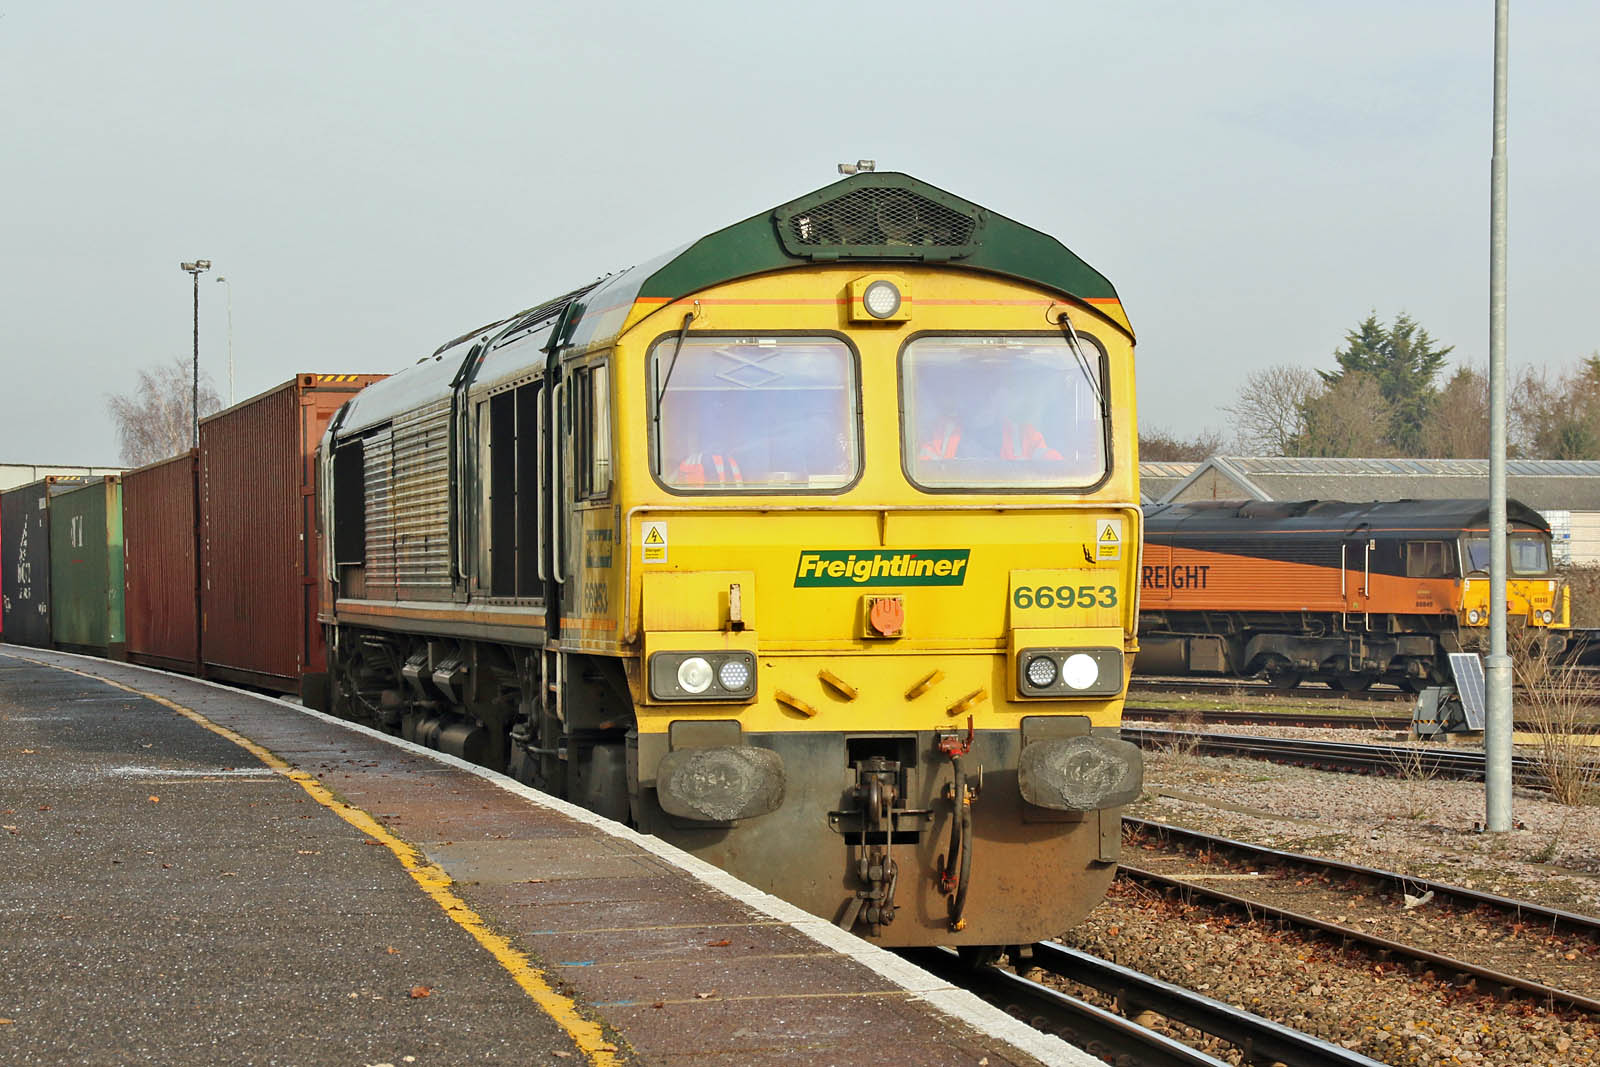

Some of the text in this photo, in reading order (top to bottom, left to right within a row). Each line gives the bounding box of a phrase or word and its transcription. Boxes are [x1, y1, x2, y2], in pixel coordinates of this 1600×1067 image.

[798, 553, 966, 583] Freightliner
[1142, 565, 1209, 589] REIGHT
[1013, 586, 1118, 609] 66953
